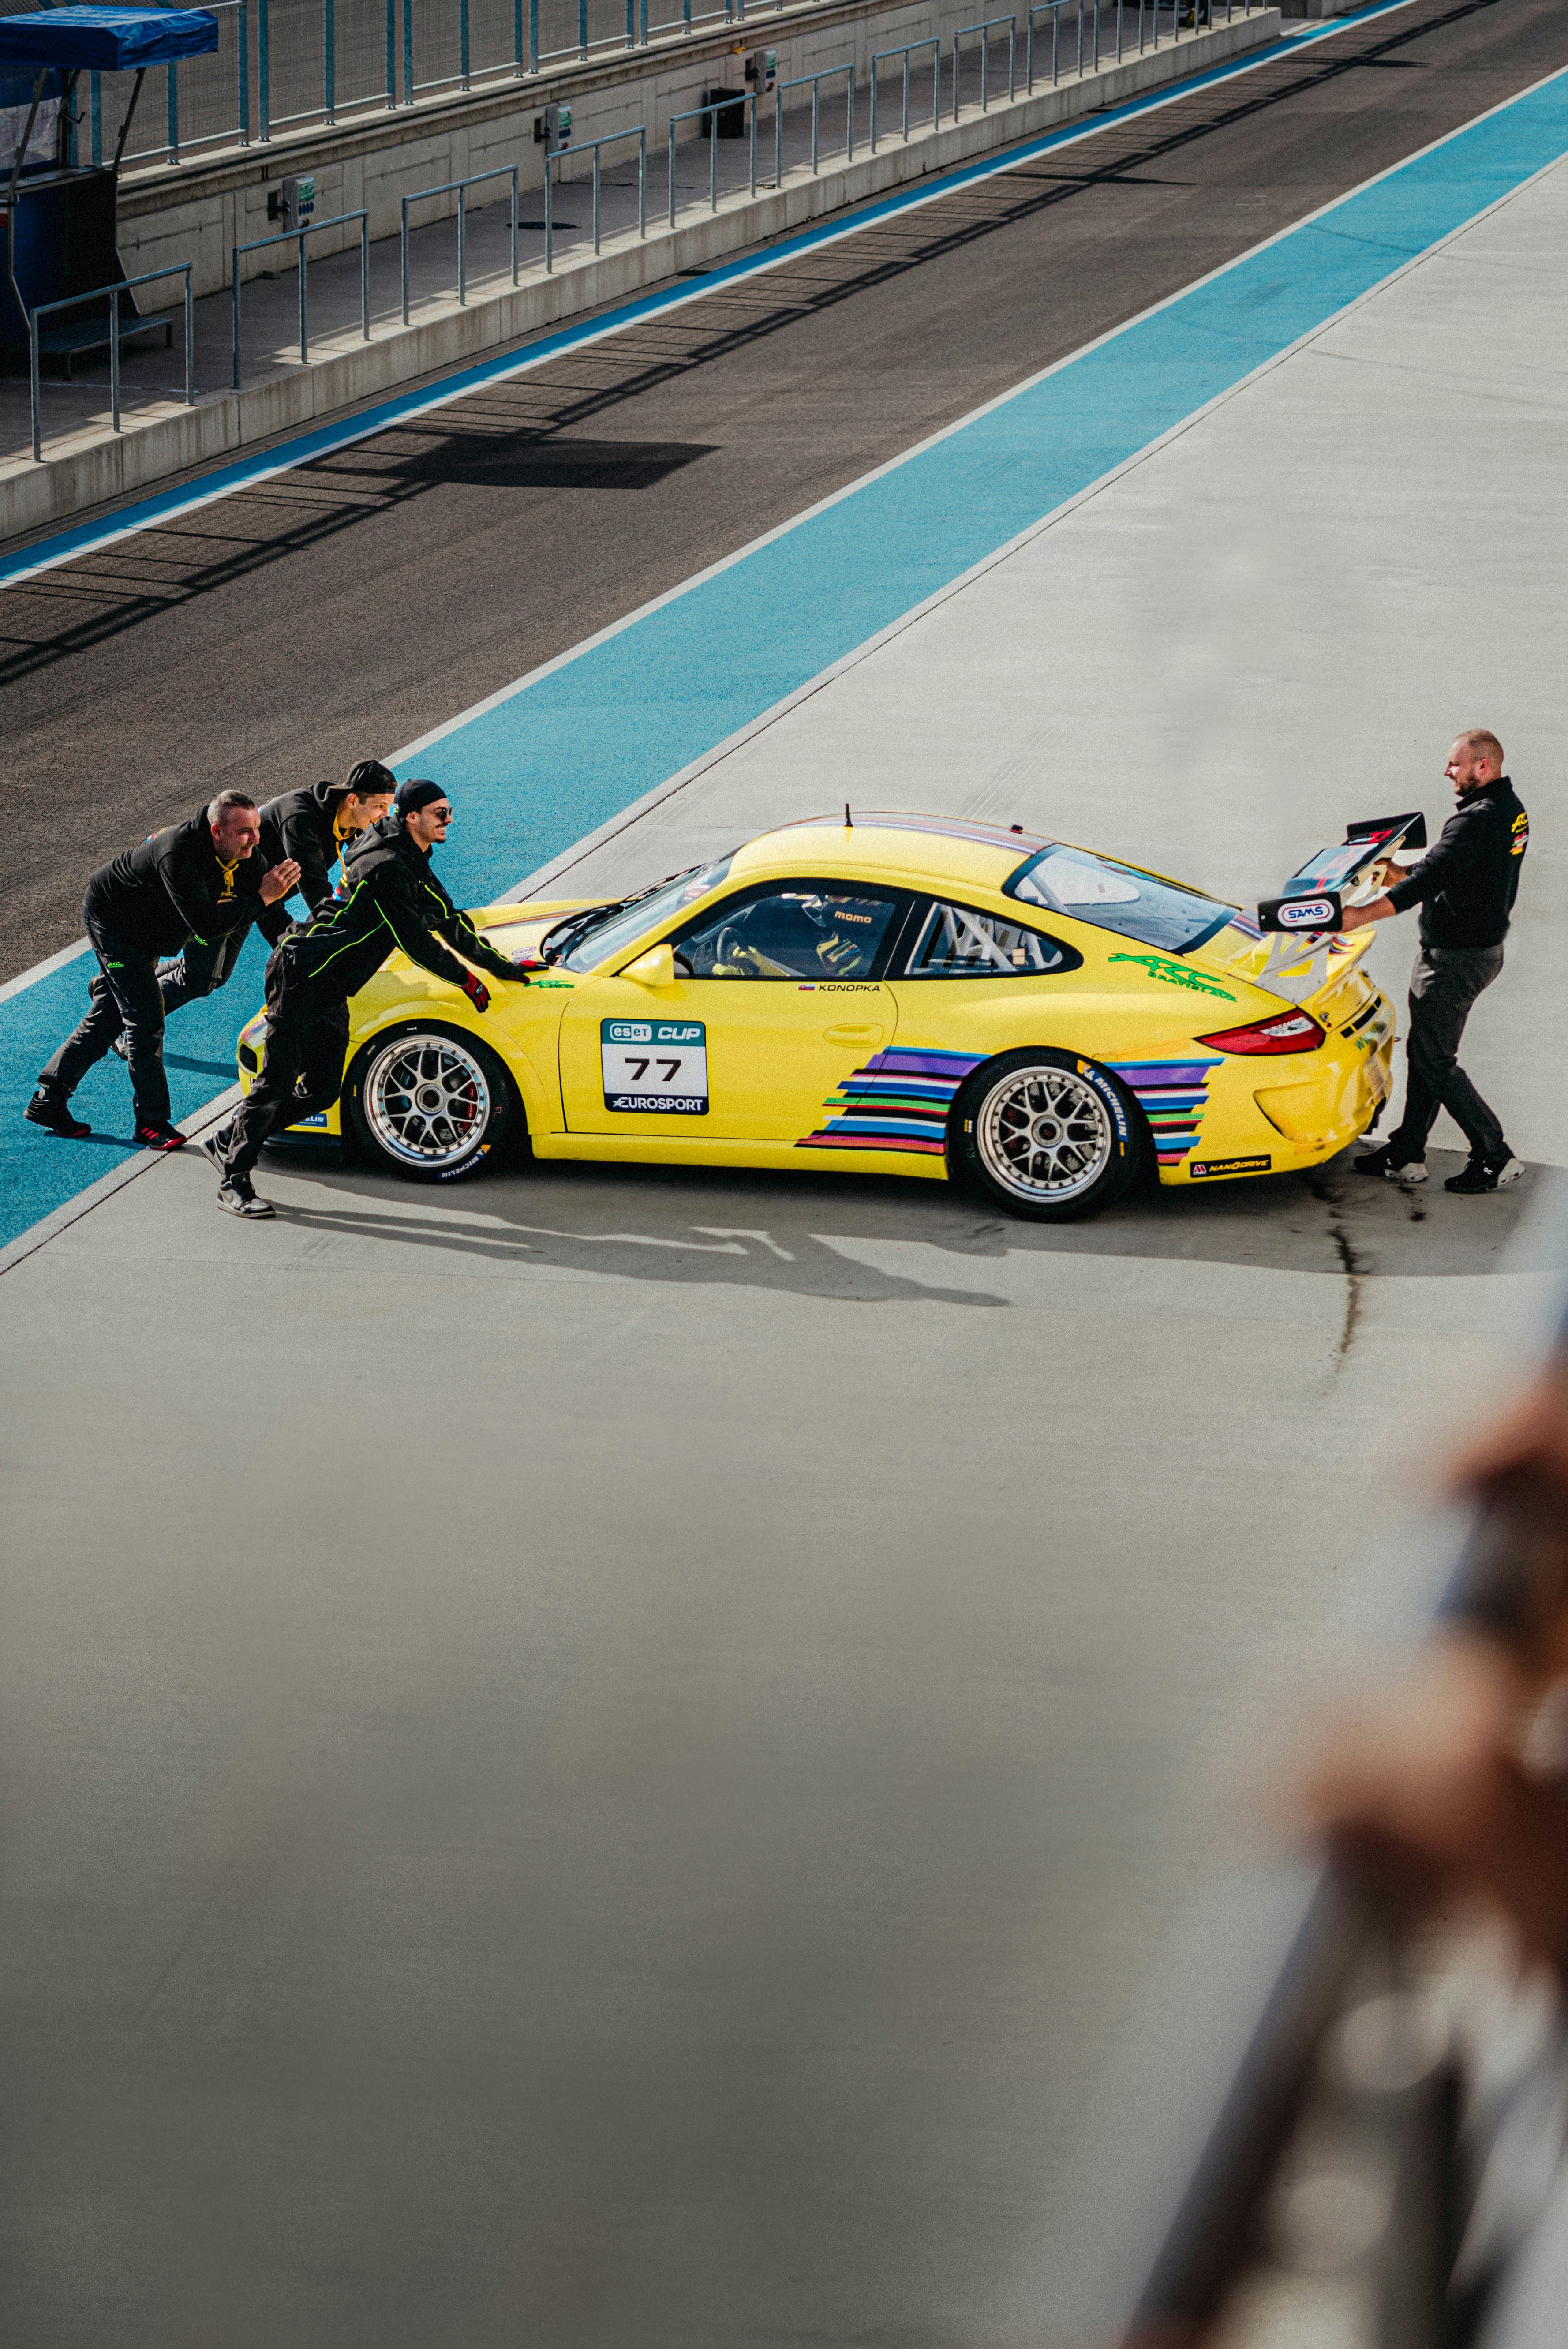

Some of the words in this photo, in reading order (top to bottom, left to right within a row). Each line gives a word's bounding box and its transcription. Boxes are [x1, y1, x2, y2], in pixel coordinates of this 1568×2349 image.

[834, 910, 872, 923] momo
[1289, 906, 1323, 918] SAMS
[658, 1027, 700, 1040] CUP
[625, 1057, 681, 1081] 77
[617, 1097, 703, 1111] EUROSPORT
[1095, 1077, 1127, 1136] MICHELIN
[442, 1155, 479, 1178] MICHELIN
[1209, 1160, 1269, 1172] NANODRIVE
